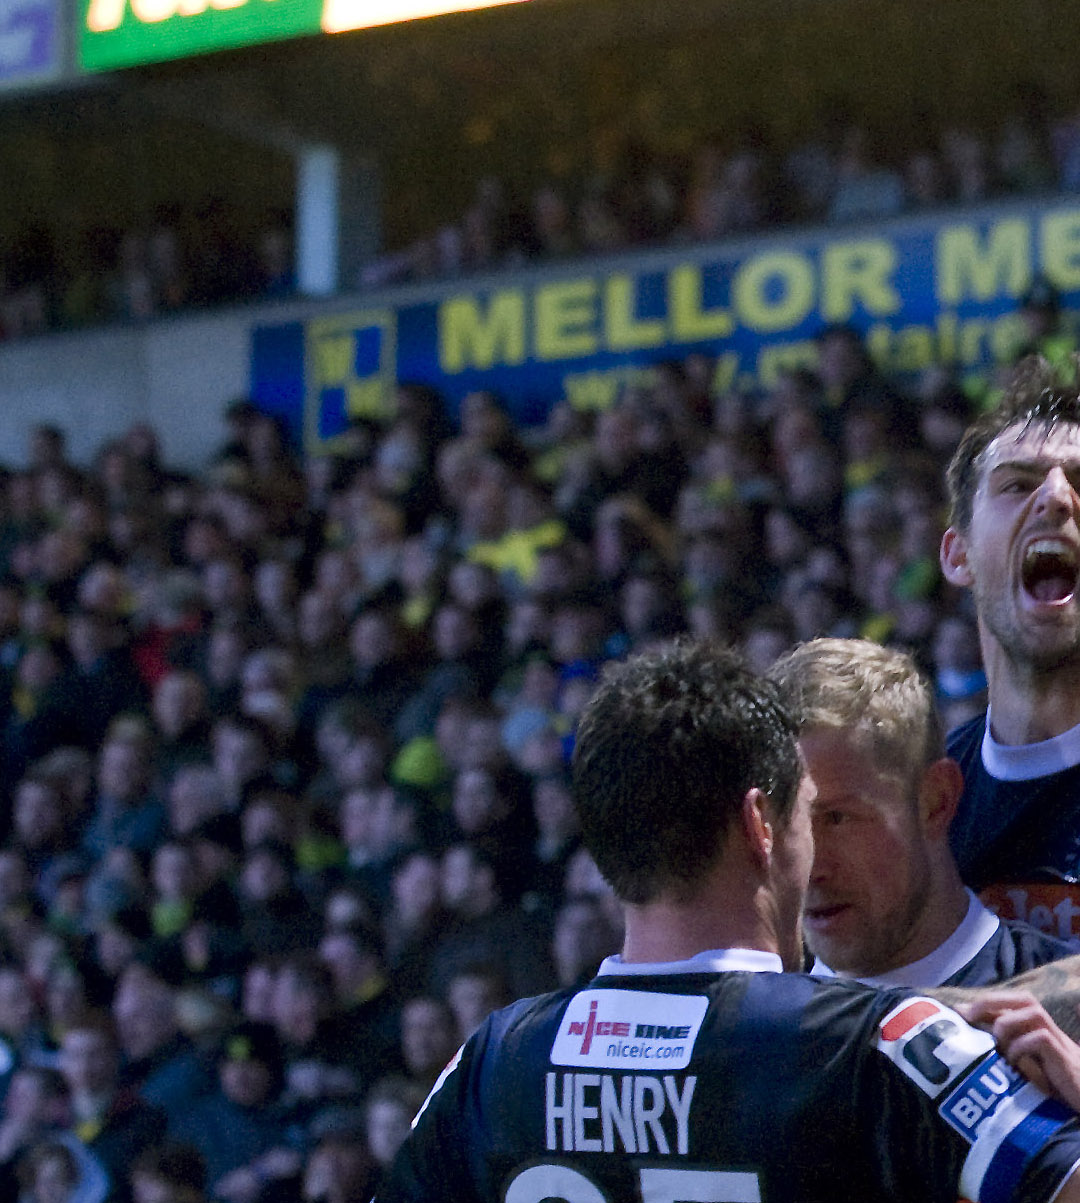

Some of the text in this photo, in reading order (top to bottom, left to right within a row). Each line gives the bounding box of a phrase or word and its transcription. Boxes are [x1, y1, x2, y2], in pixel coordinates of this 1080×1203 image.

[438, 238, 900, 376] MELLOR
[606, 1040, 685, 1058] niceic.com
[545, 1072, 698, 1155] HENRY
